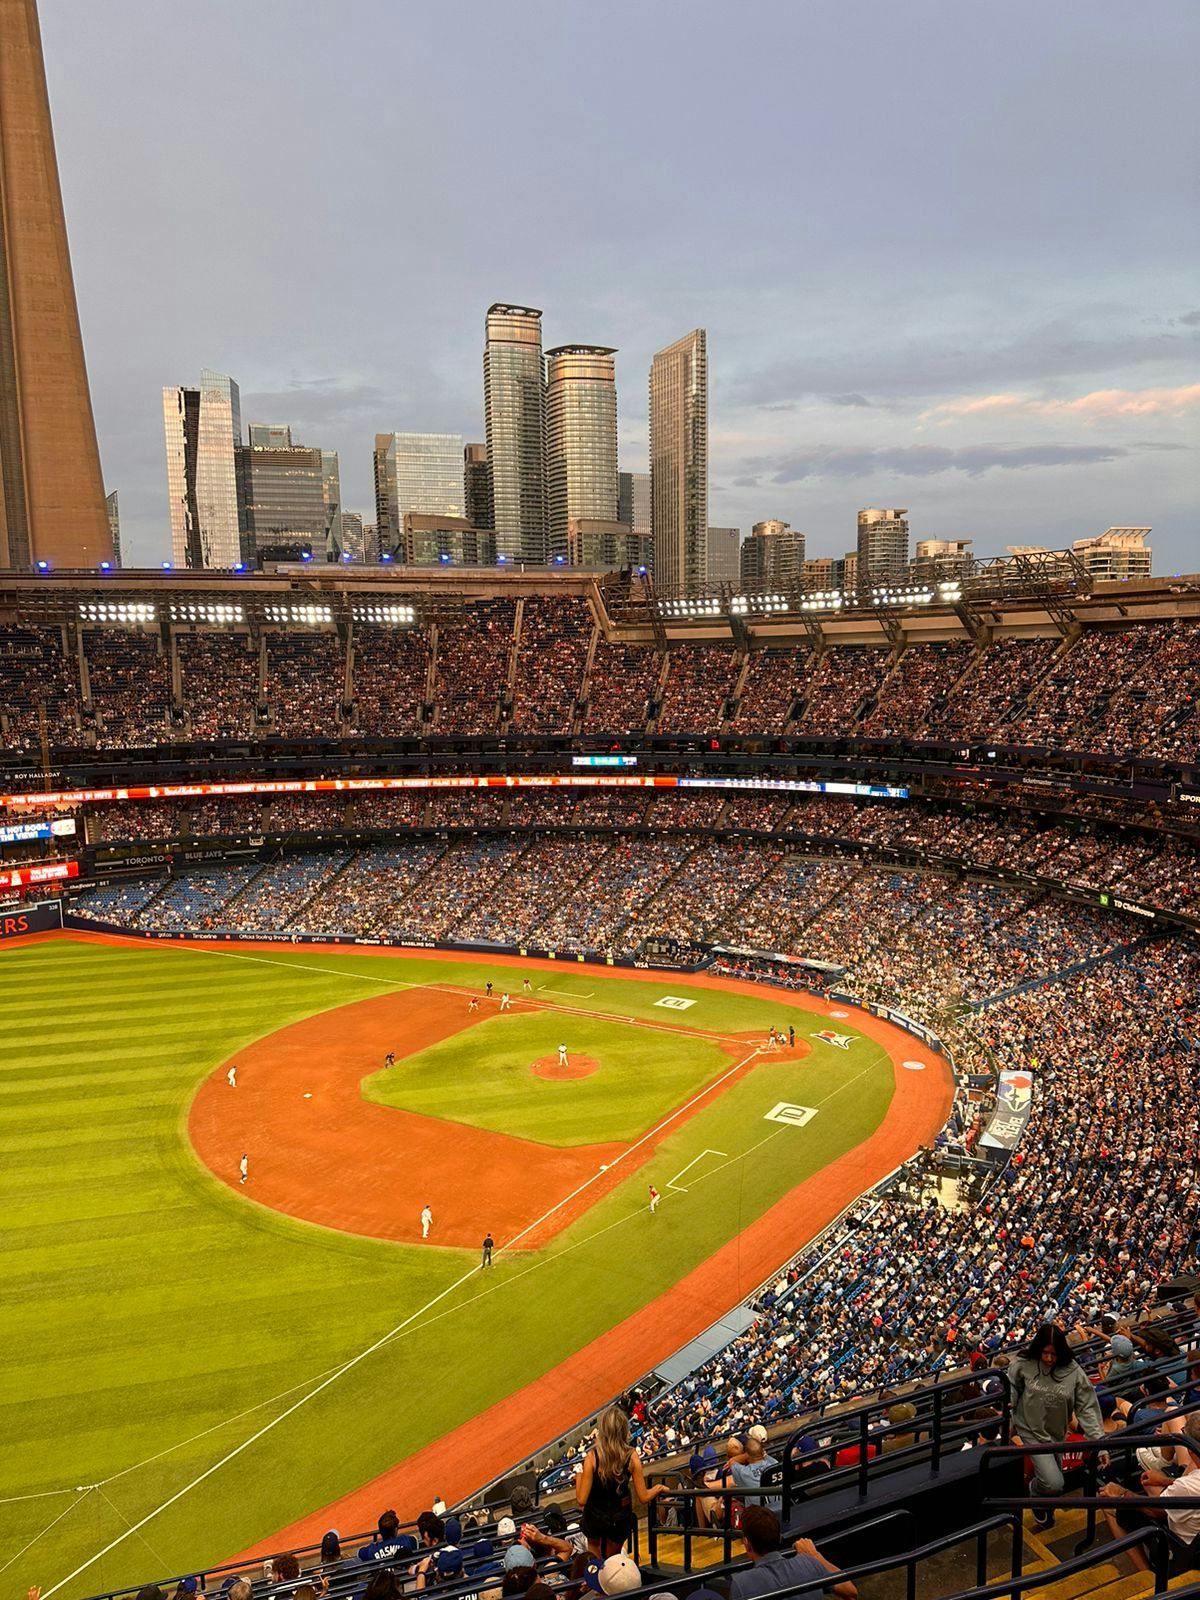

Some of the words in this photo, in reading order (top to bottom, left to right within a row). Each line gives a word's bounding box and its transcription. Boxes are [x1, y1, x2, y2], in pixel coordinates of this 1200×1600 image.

[125, 855, 164, 865] TORONTO
[1113, 899, 1123, 908] TD
[1123, 902, 1155, 918] Clubhouse
[0, 915, 29, 934] RS
[634, 961, 649, 969] VISA
[771, 1471, 783, 1483] 53
